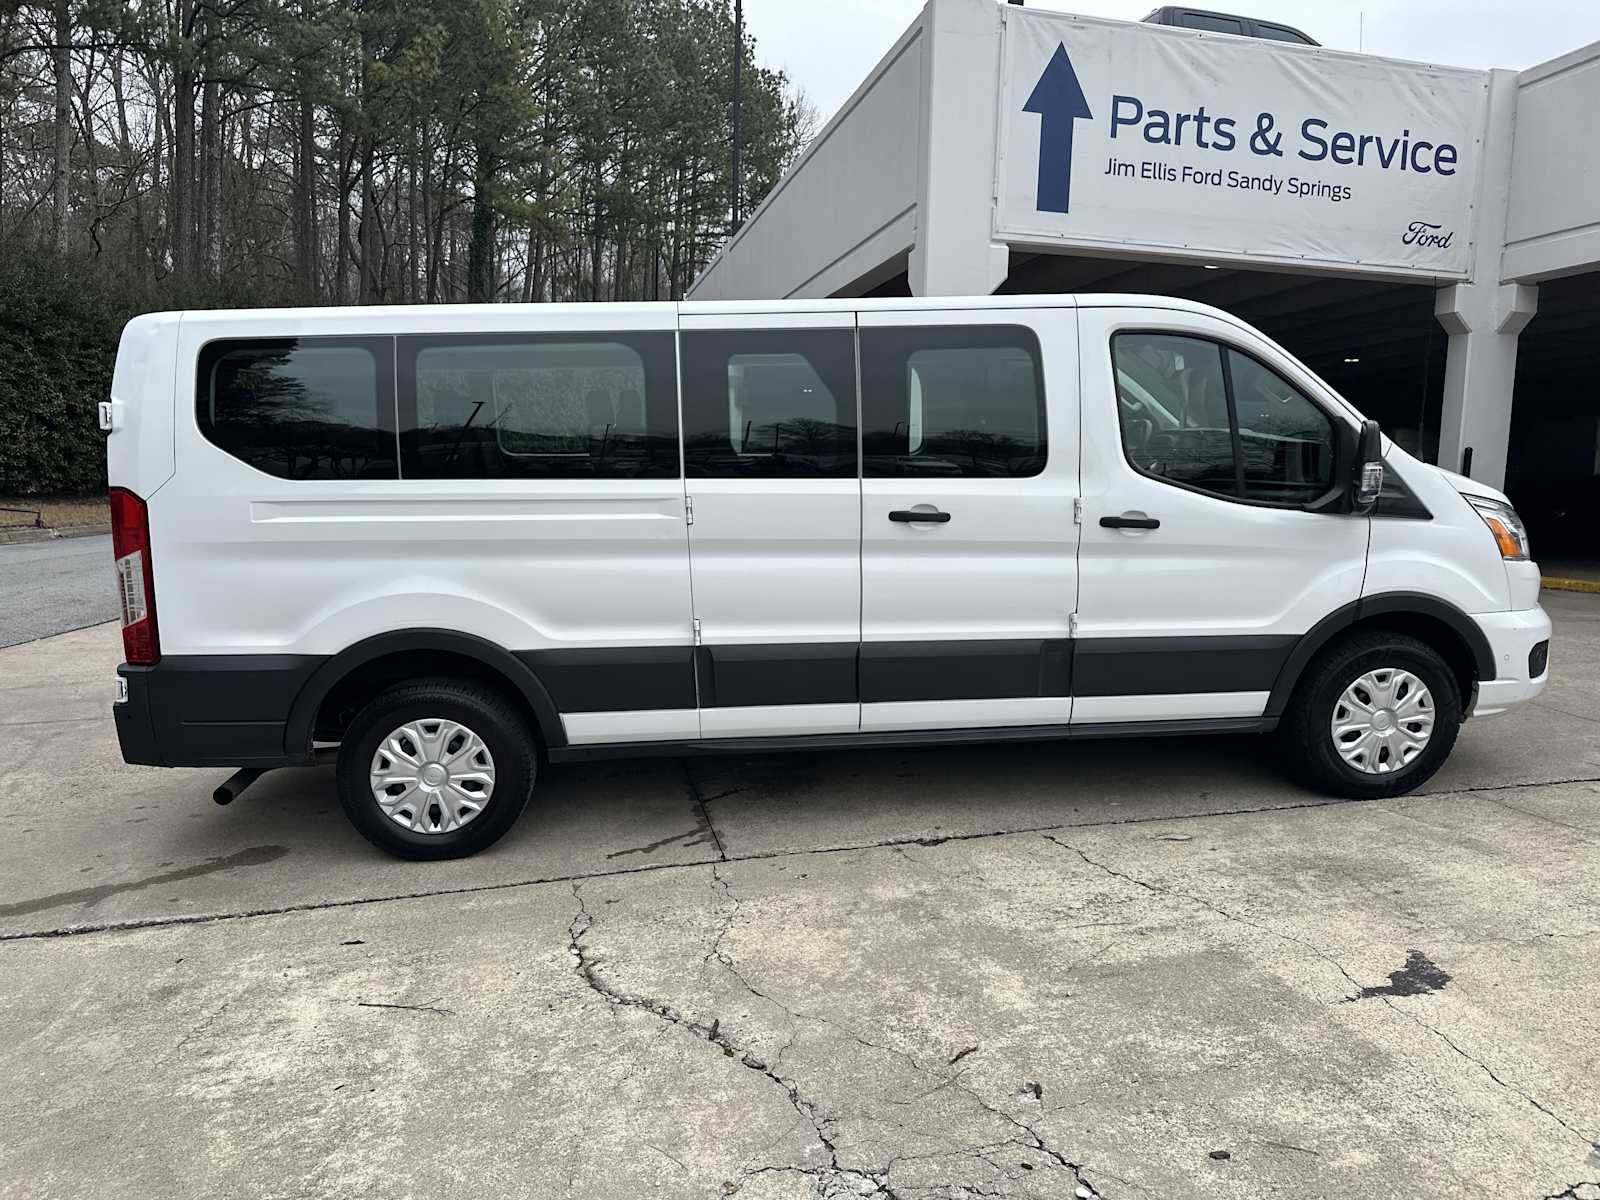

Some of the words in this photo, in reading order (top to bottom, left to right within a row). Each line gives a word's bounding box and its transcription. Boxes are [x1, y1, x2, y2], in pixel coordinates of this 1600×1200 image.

[1110, 94, 1237, 152] Parts
[1249, 112, 1284, 158] &
[1297, 118, 1458, 176] Service
[1104, 157, 1136, 178] Jim
[1140, 161, 1177, 182] Ellis
[1181, 165, 1223, 187] Ford
[1226, 170, 1284, 196] Sandy
[1287, 177, 1352, 203] Springs
[1401, 220, 1454, 249] Ford
